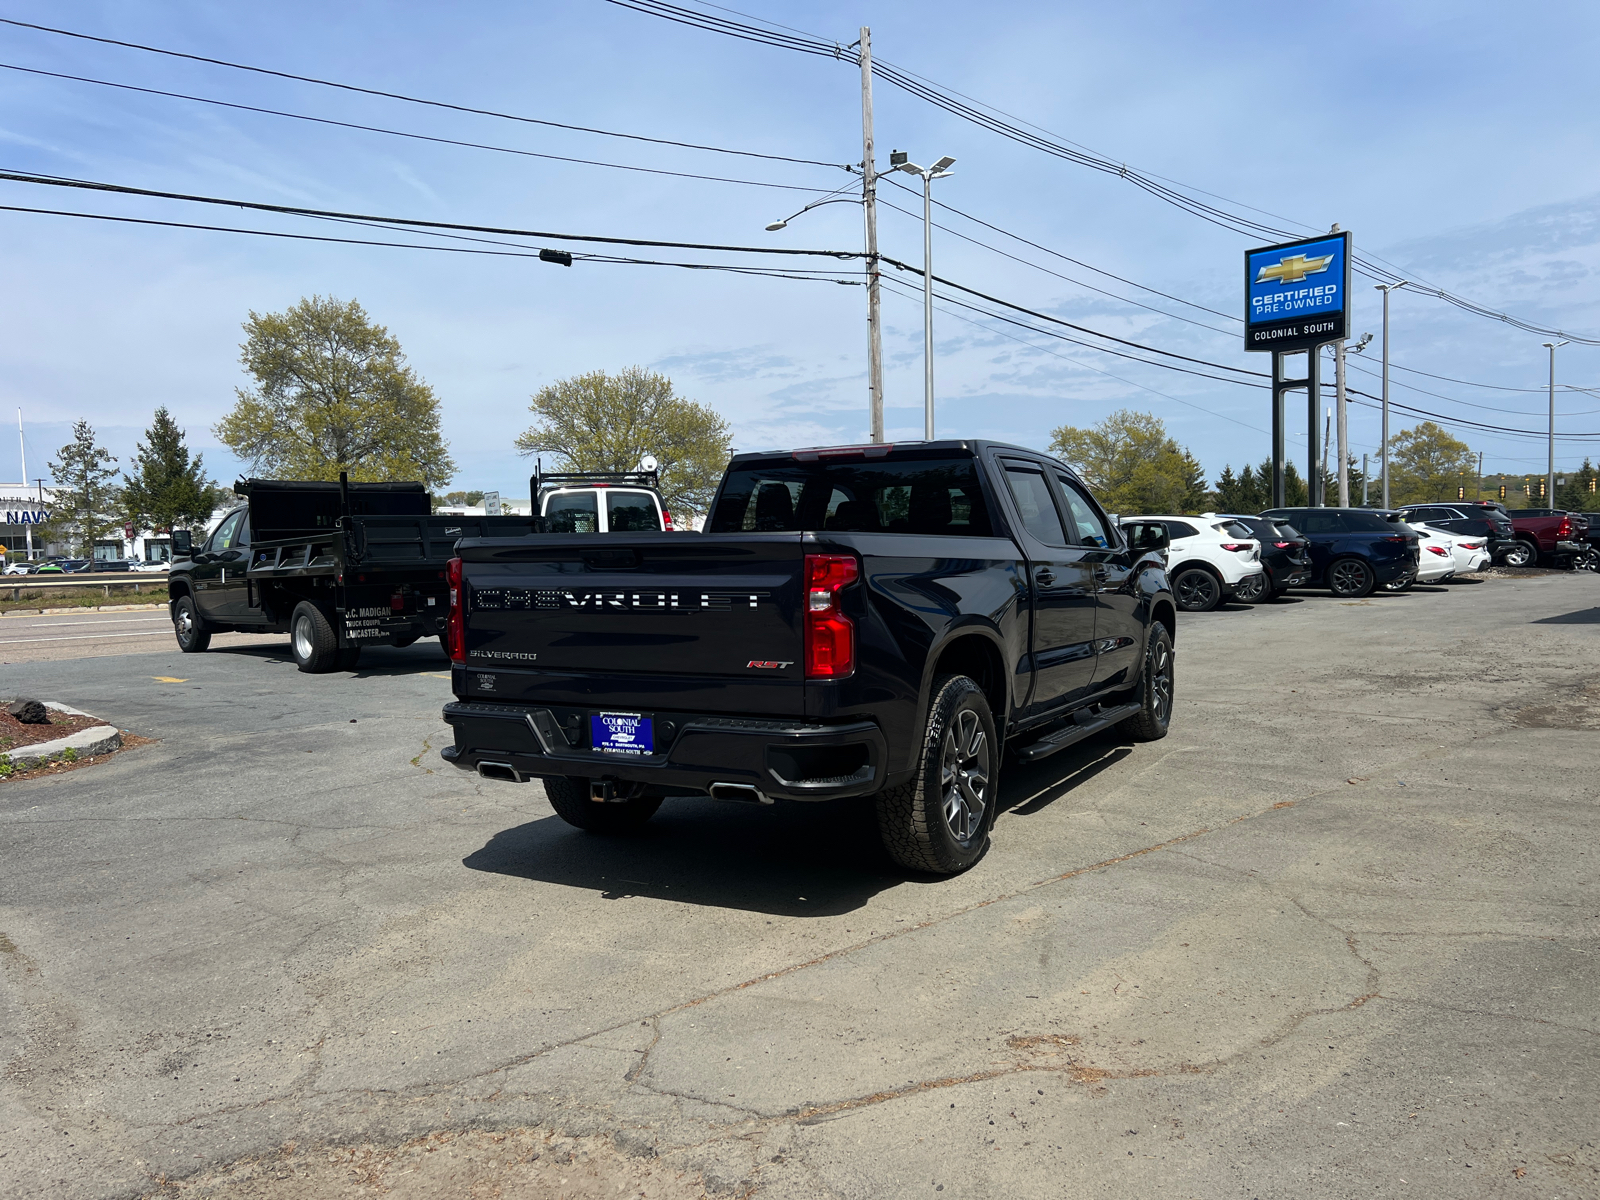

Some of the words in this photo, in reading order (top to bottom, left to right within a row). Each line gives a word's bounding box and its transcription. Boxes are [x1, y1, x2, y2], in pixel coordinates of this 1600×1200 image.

[1252, 284, 1337, 306] CERTIFIED
[1256, 295, 1333, 315] PRE-OWNED
[1254, 327, 1299, 341] COLONIAL
[1303, 321, 1334, 334] SOUTH
[6, 511, 53, 525] NAVY
[477, 590, 771, 611] CHEVROLET
[345, 608, 358, 619] J.C.
[359, 607, 391, 617] MADIGAN
[345, 620, 362, 628] TRUCK
[469, 650, 537, 660] SILVERADO
[746, 660, 795, 669] RST
[602, 717, 641, 726] COLONIAL
[608, 725, 635, 733] SOUTH
